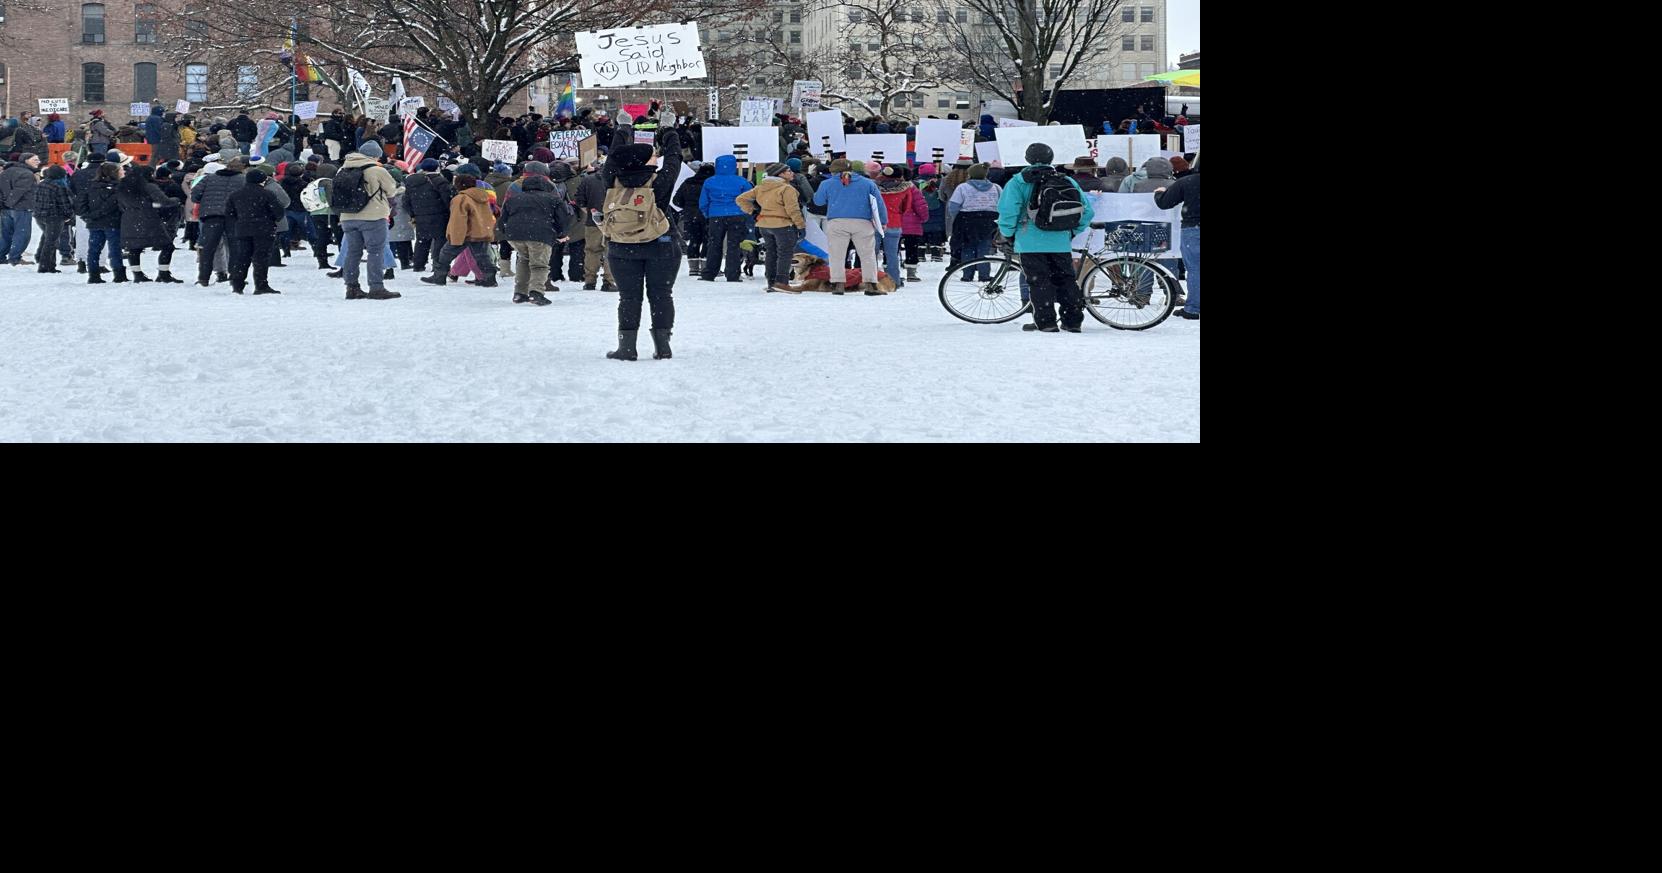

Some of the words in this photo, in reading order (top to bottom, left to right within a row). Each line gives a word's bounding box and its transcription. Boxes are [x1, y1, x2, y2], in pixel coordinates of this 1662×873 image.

[598, 32, 681, 50] Jesus
[626, 61, 654, 76] UR
[655, 59, 702, 77] Neighbor
[743, 113, 770, 122] LAW
[551, 129, 591, 139] VETERANS
